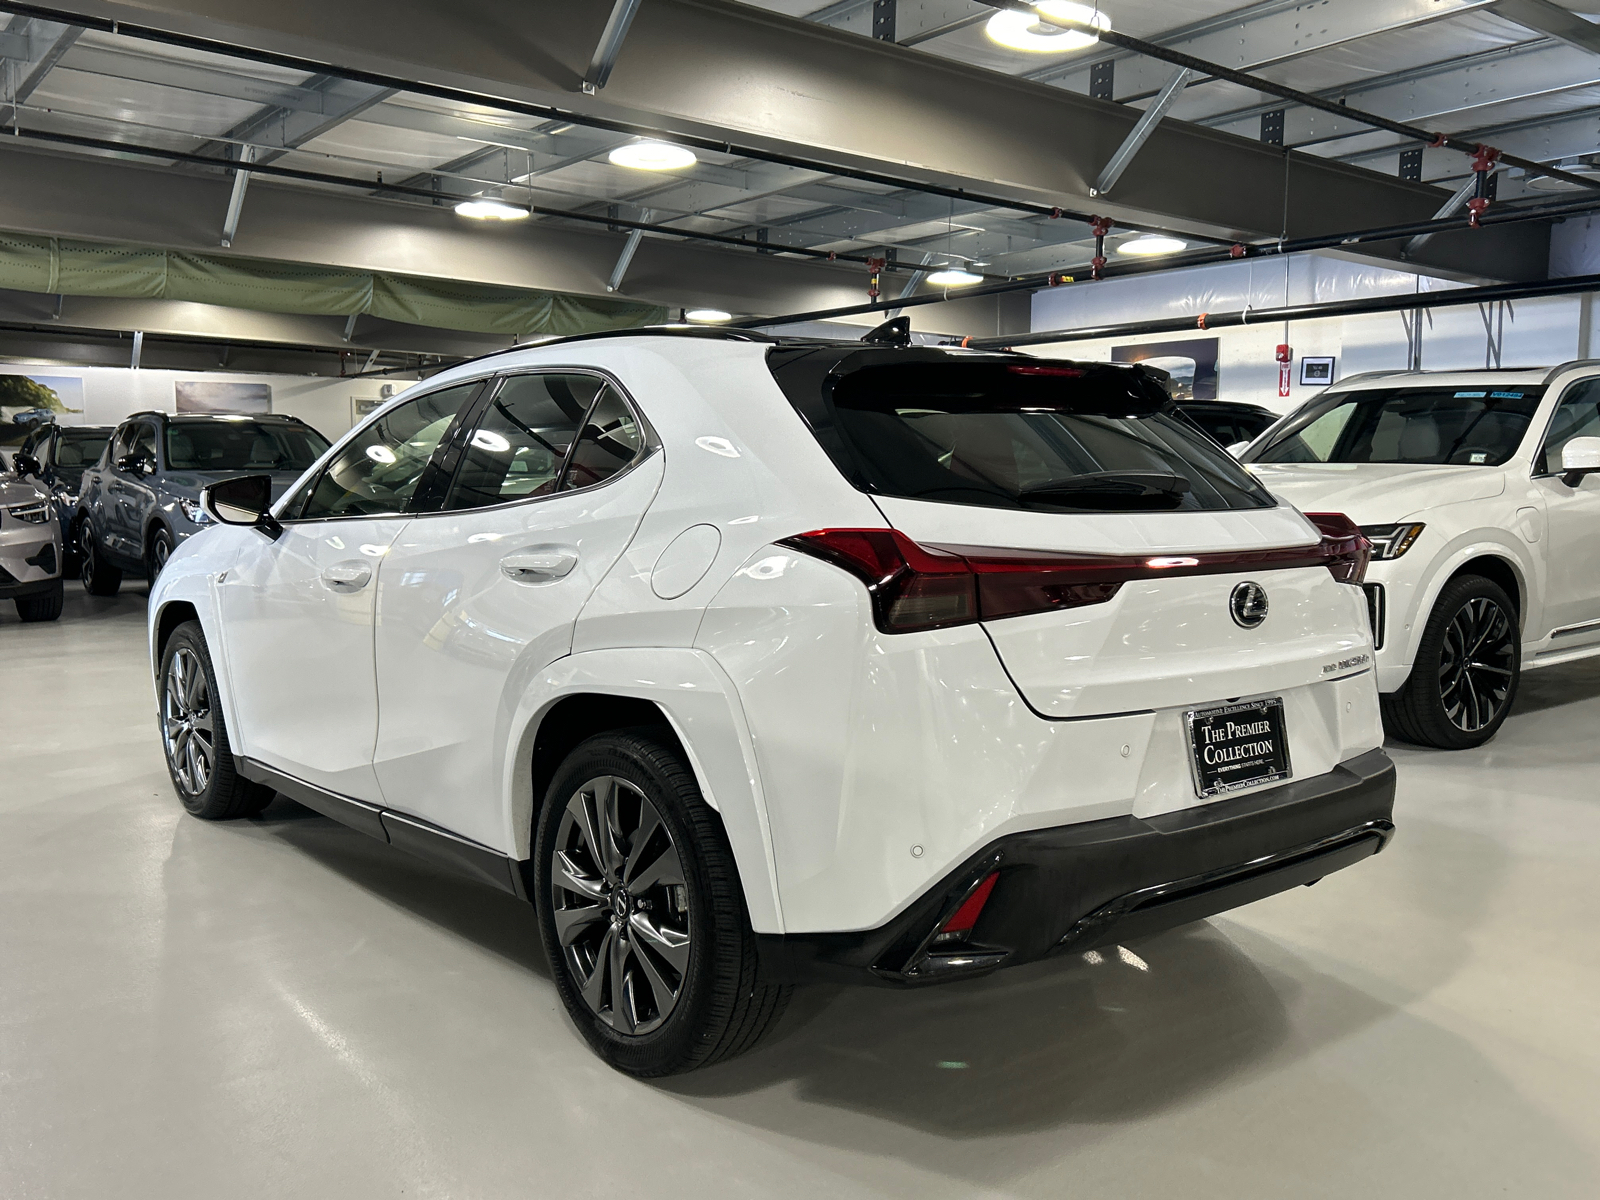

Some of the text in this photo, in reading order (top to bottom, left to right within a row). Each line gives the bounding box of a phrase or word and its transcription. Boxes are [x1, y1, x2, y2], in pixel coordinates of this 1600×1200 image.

[1201, 720, 1271, 744] THE PREMIER
[1203, 740, 1274, 765] COLLECTION
[1217, 763, 1242, 773] EVERYTHING
